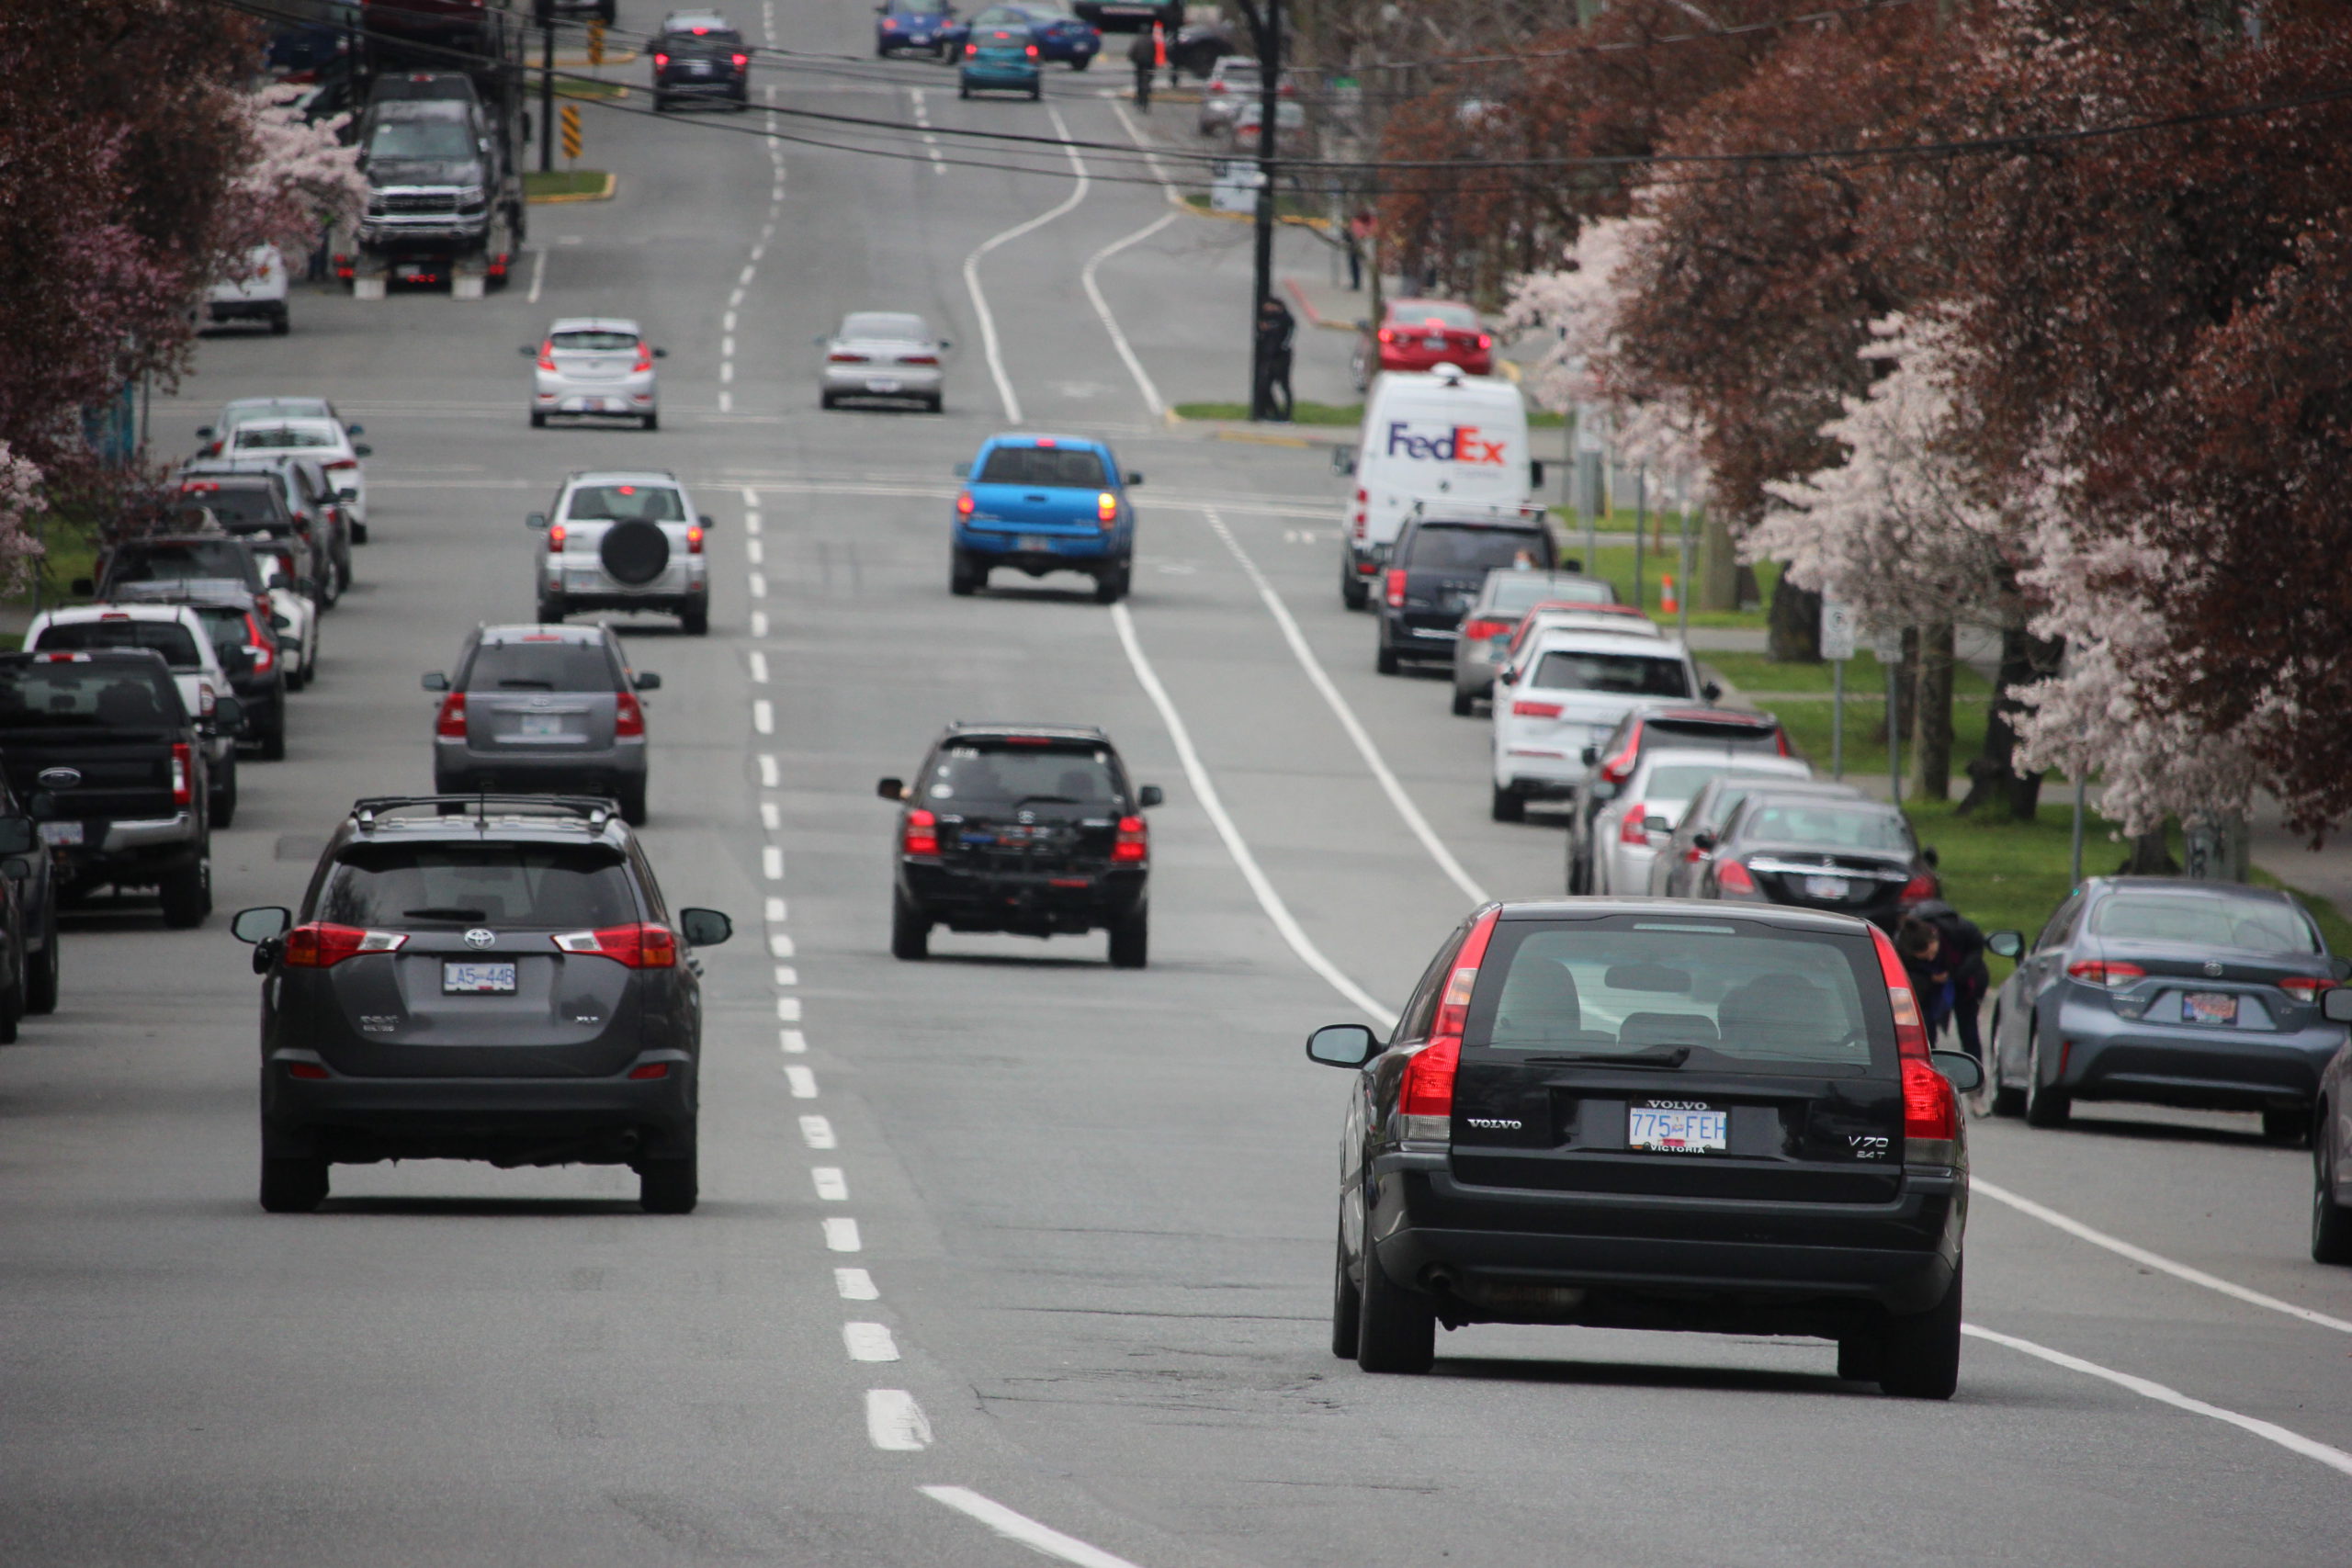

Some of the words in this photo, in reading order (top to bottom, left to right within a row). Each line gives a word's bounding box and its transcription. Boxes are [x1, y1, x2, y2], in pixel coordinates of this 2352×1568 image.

[1387, 422, 1507, 467] FedEx
[1648, 1100, 1708, 1111] VOLVO
[1467, 1118, 1522, 1130] VOLVO
[1632, 1113, 1671, 1138] 775
[1849, 1135, 1889, 1148] V70
[1650, 1145, 1705, 1155] VICTORIA
